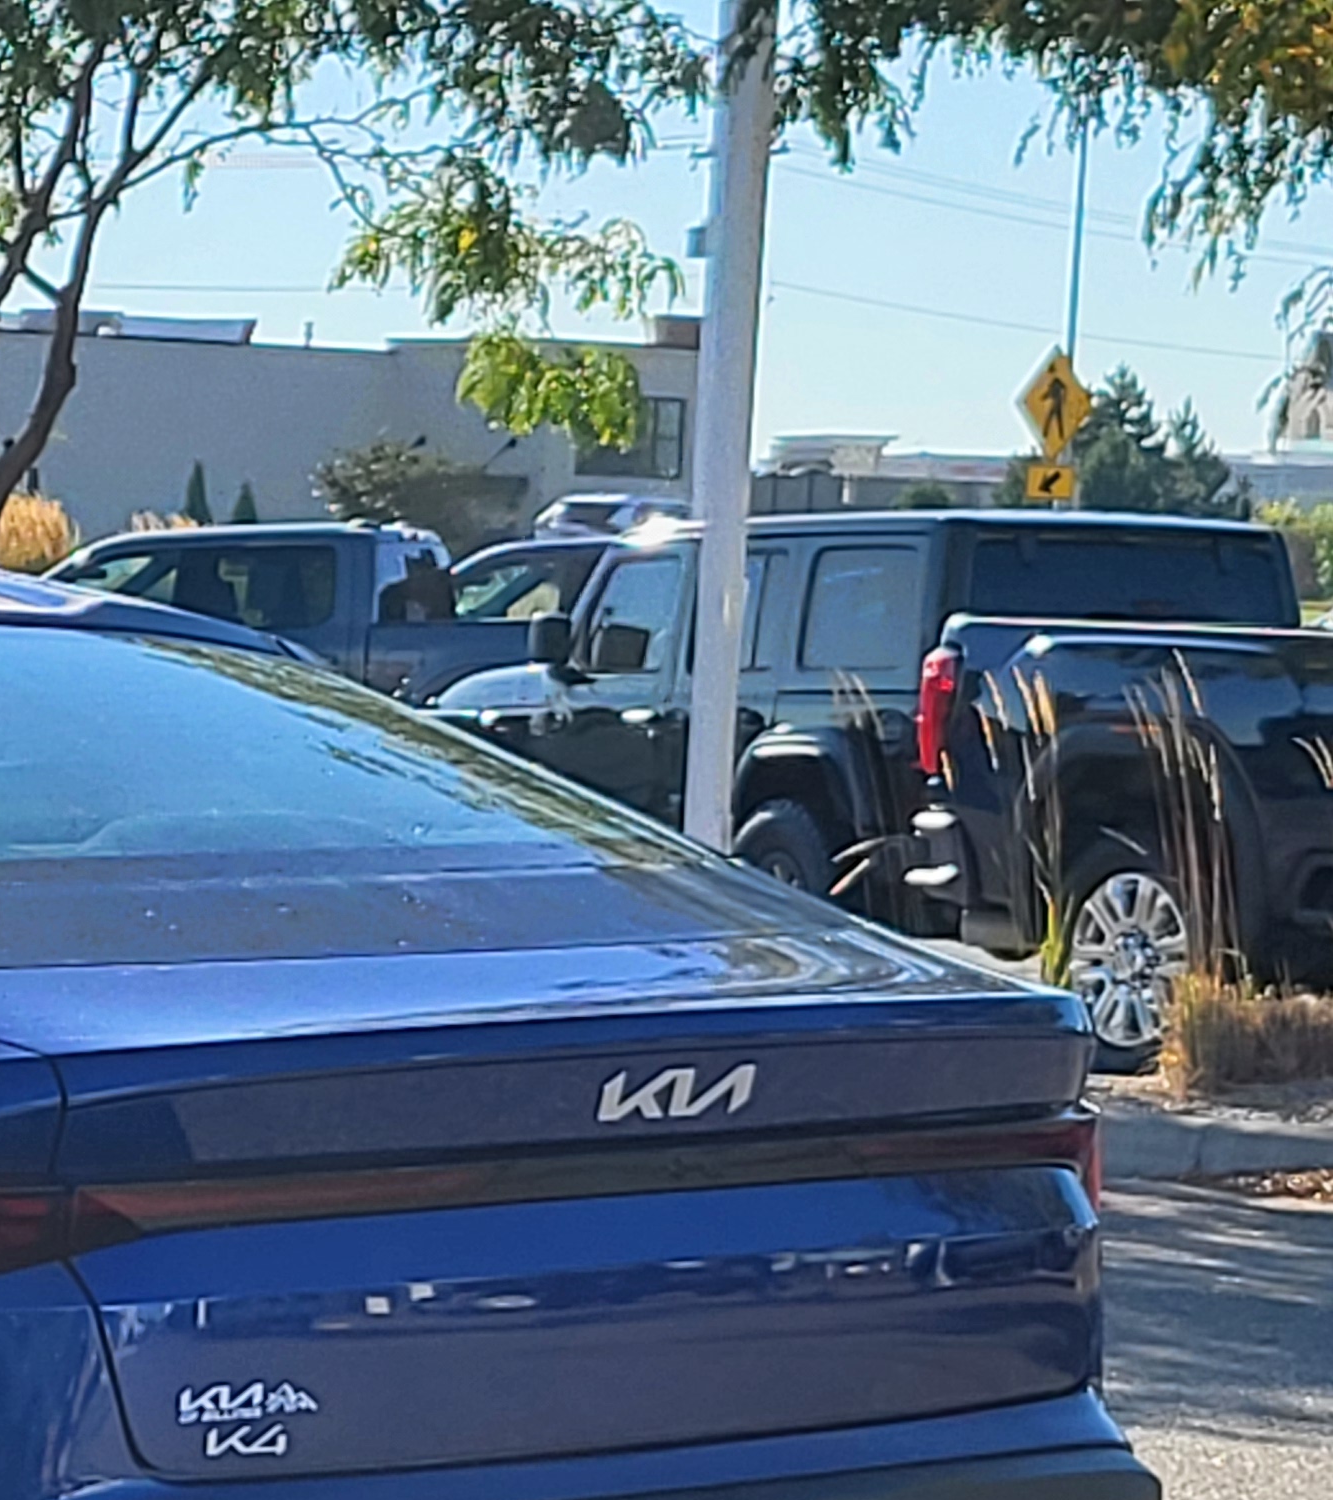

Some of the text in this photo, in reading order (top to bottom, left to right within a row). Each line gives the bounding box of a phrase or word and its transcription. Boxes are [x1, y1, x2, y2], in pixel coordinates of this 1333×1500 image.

[597, 1062, 757, 1123] KIA
[179, 1382, 264, 1413] KIA
[205, 1422, 288, 1457] K4
